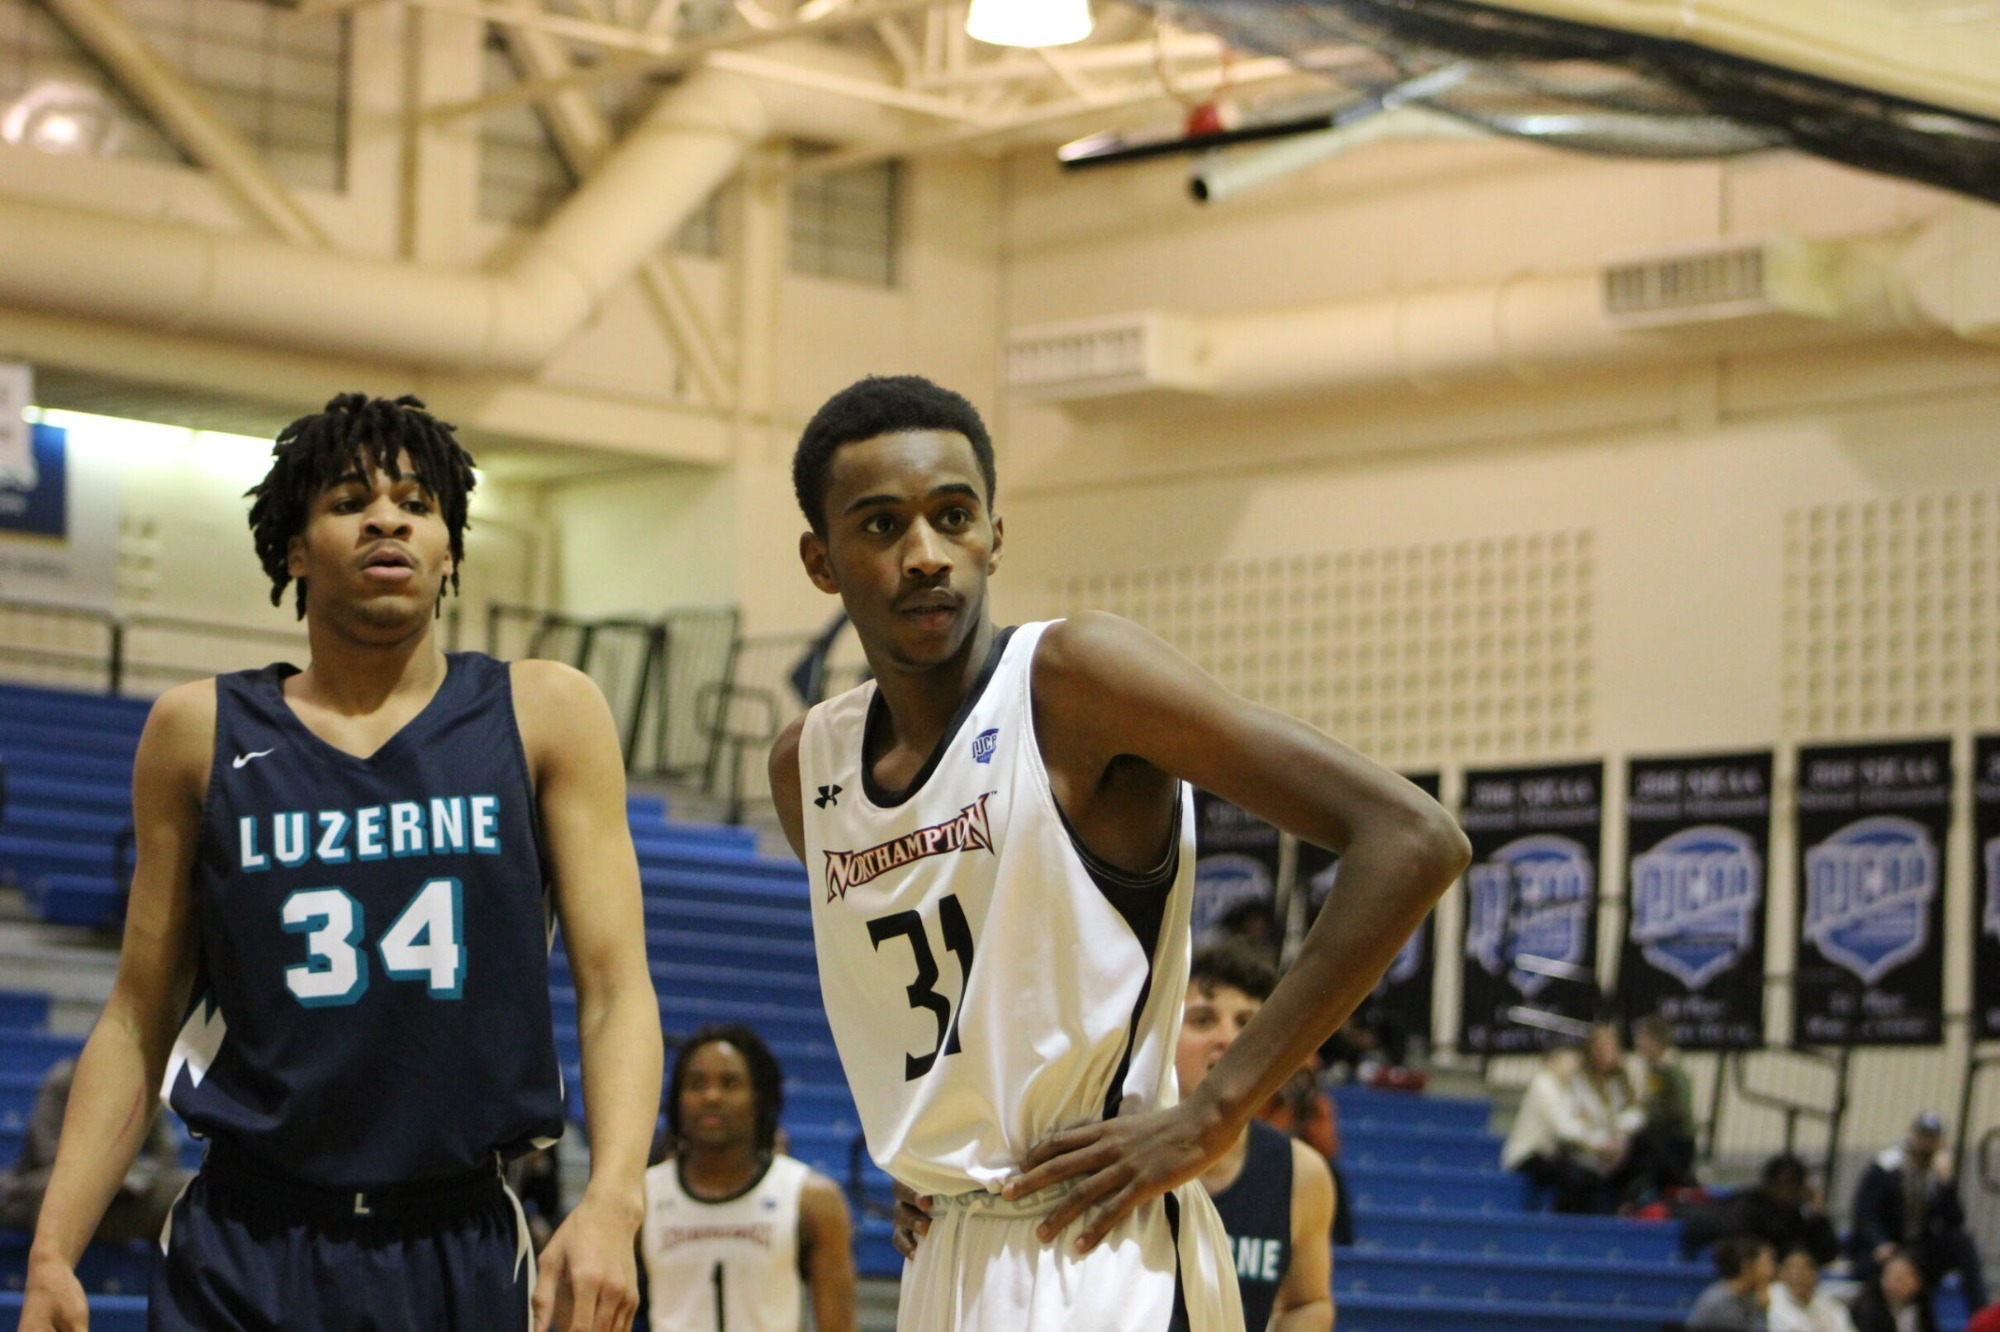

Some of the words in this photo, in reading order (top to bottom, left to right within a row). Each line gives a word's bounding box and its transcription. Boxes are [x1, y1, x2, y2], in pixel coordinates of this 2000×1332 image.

[239, 795, 501, 872] LUZERNE
[823, 792, 996, 905] NORTHAMPTON
[280, 877, 468, 1009] 34
[866, 893, 974, 1082] 31
[354, 1193, 370, 1214] L
